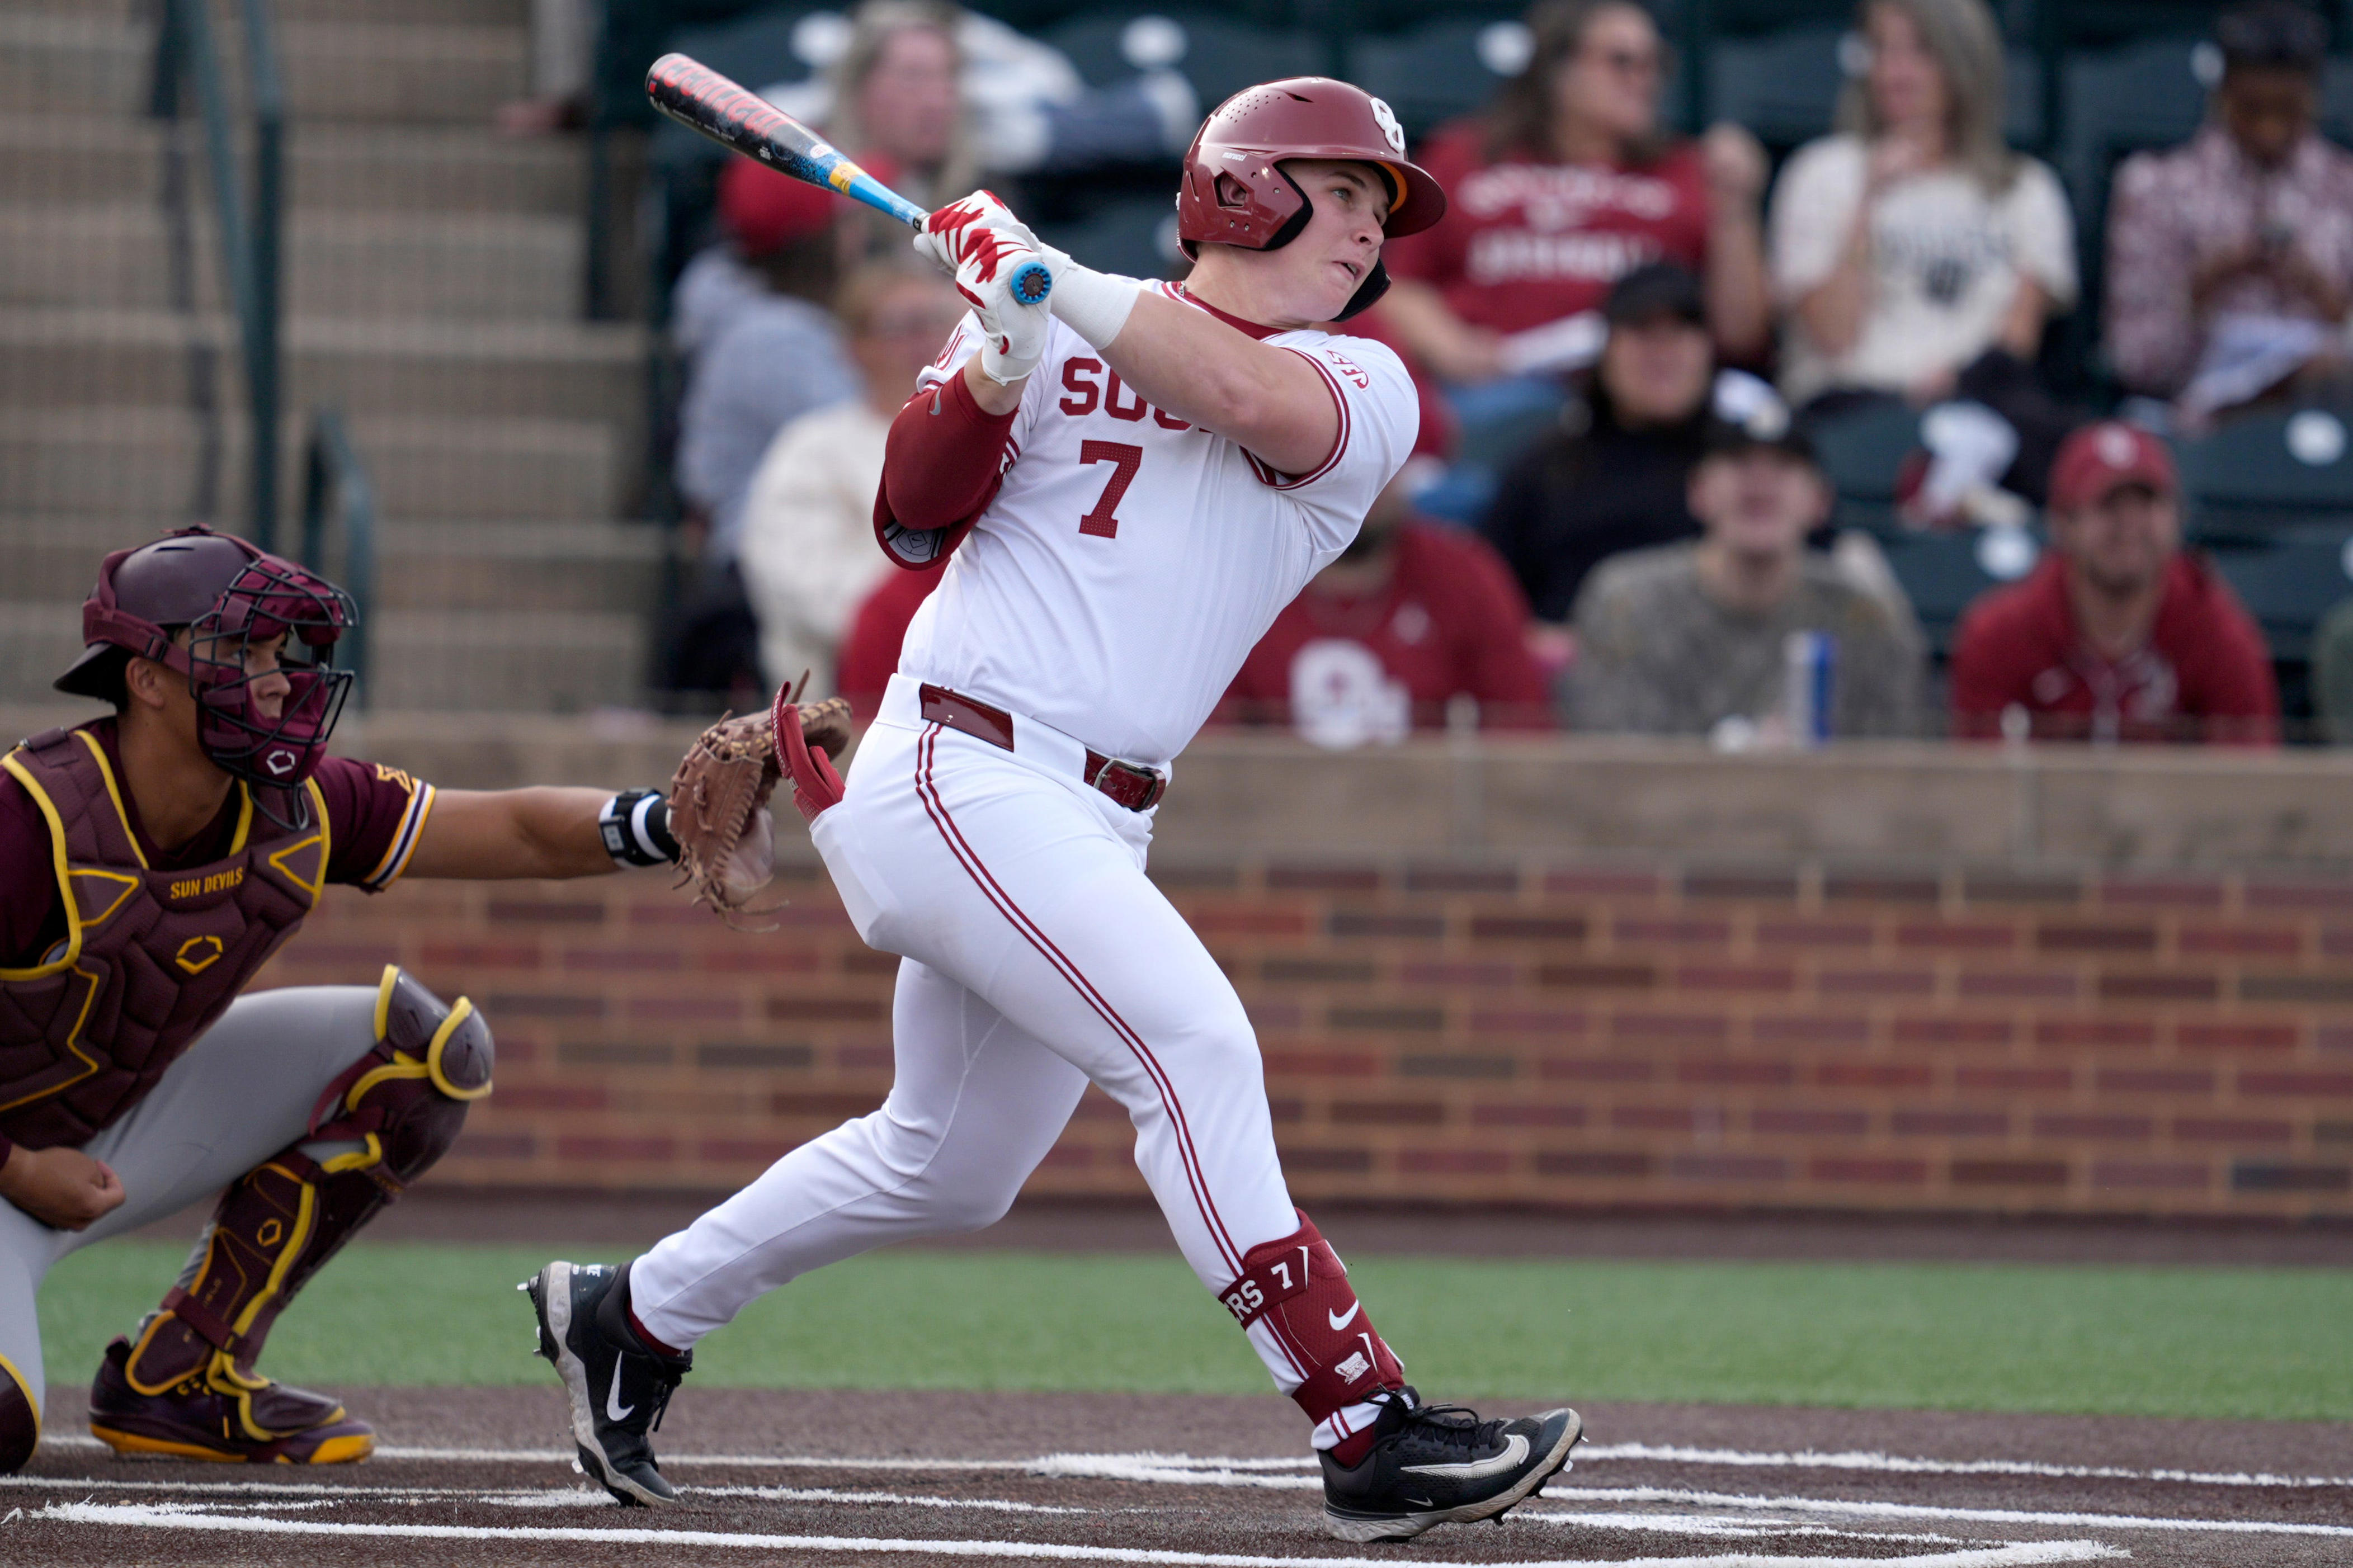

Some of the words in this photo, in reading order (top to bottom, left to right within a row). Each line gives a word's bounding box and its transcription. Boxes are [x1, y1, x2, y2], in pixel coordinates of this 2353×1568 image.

[1079, 440, 1143, 539] 7
[171, 879, 200, 899] SUN
[204, 866, 243, 893] DEVILS
[1224, 1280, 1264, 1323] RS
[1270, 1262, 1293, 1290] 7
